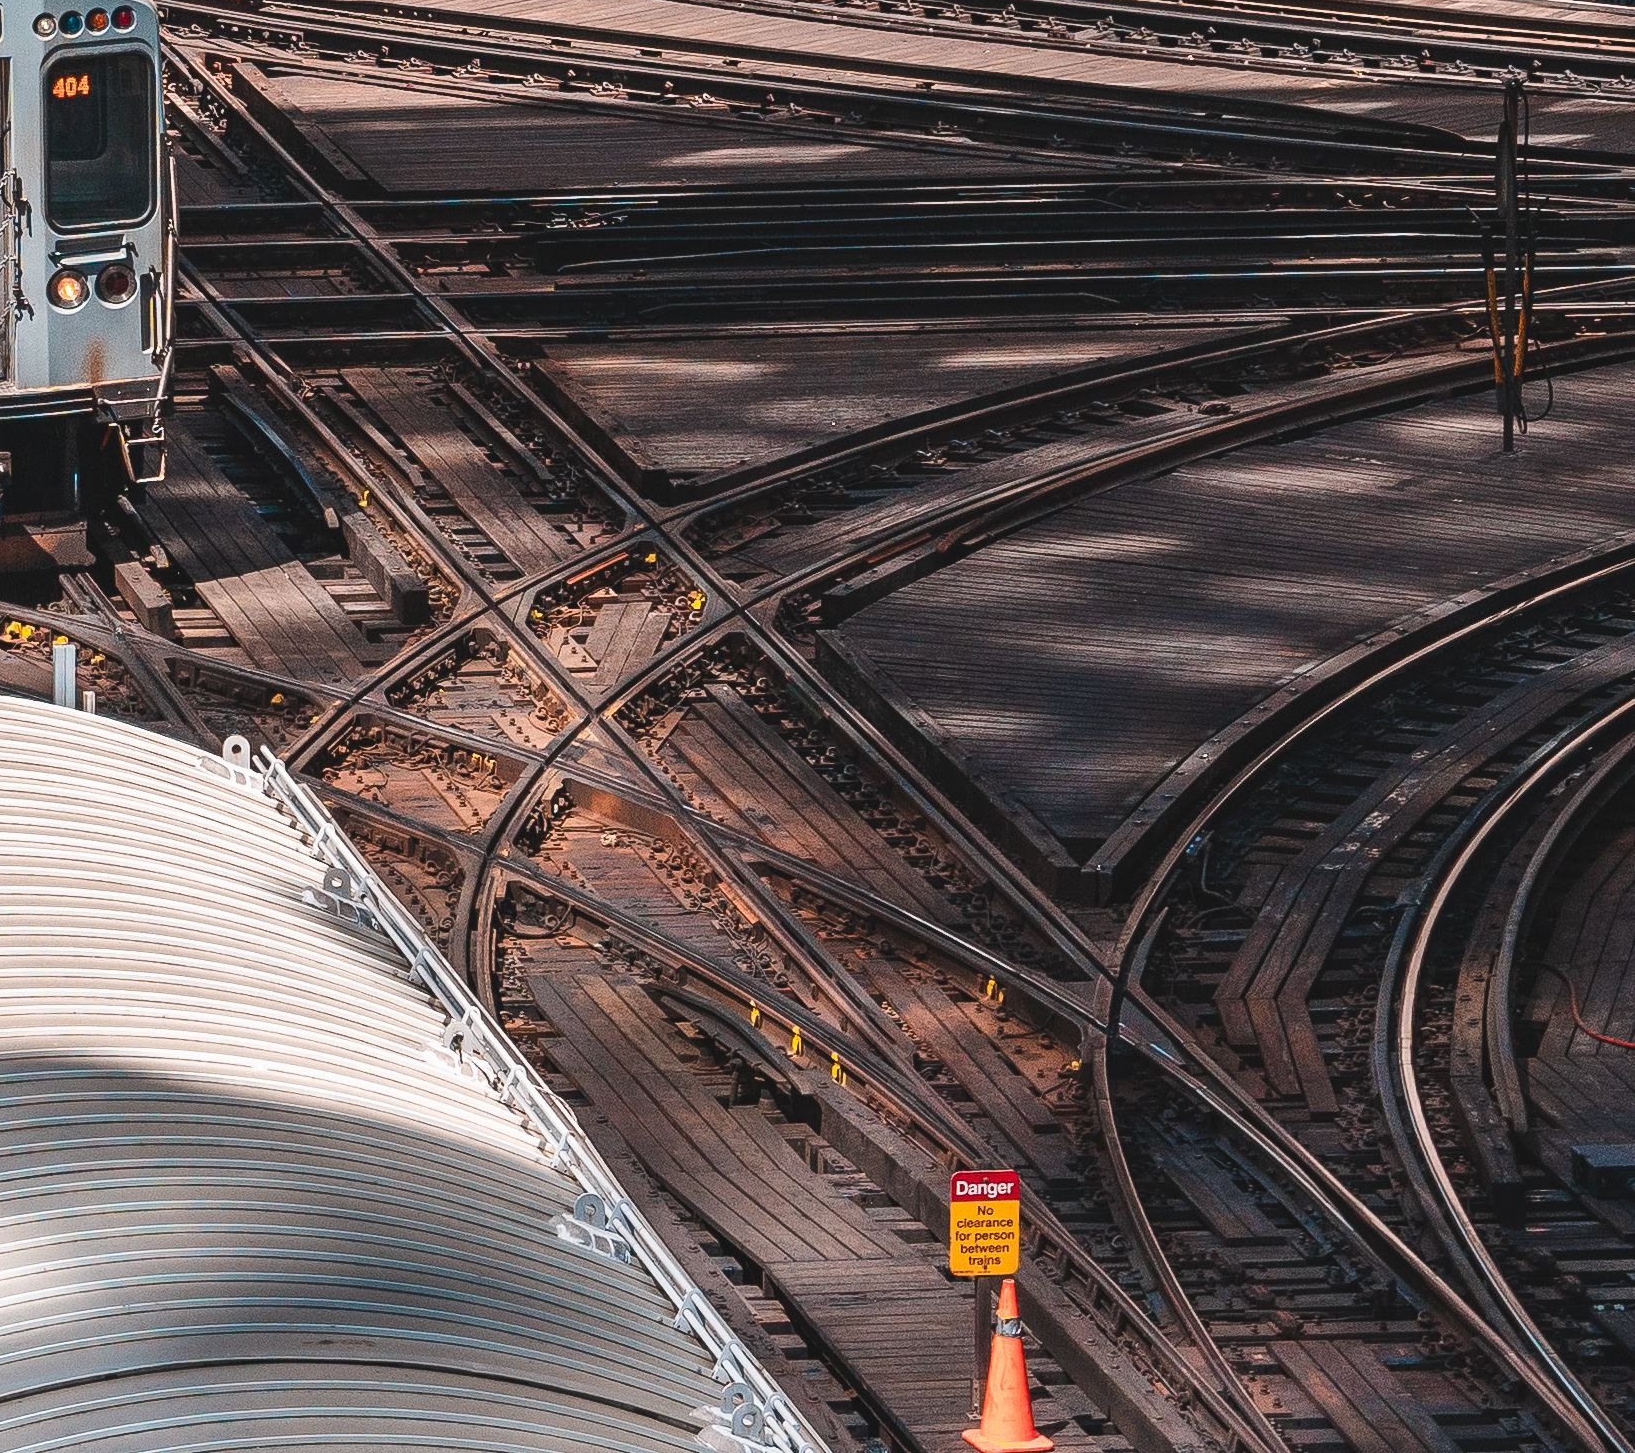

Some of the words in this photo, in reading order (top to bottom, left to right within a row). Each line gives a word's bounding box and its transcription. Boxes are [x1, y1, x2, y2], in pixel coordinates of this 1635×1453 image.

[53, 74, 90, 98] 404
[956, 1180, 1014, 1198] Danger
[977, 1206, 994, 1216] No
[956, 1218, 1014, 1229] clearance
[955, 1231, 972, 1241] for
[974, 1231, 1015, 1243] person
[960, 1244, 1010, 1254] between
[968, 1255, 1001, 1266] trains
